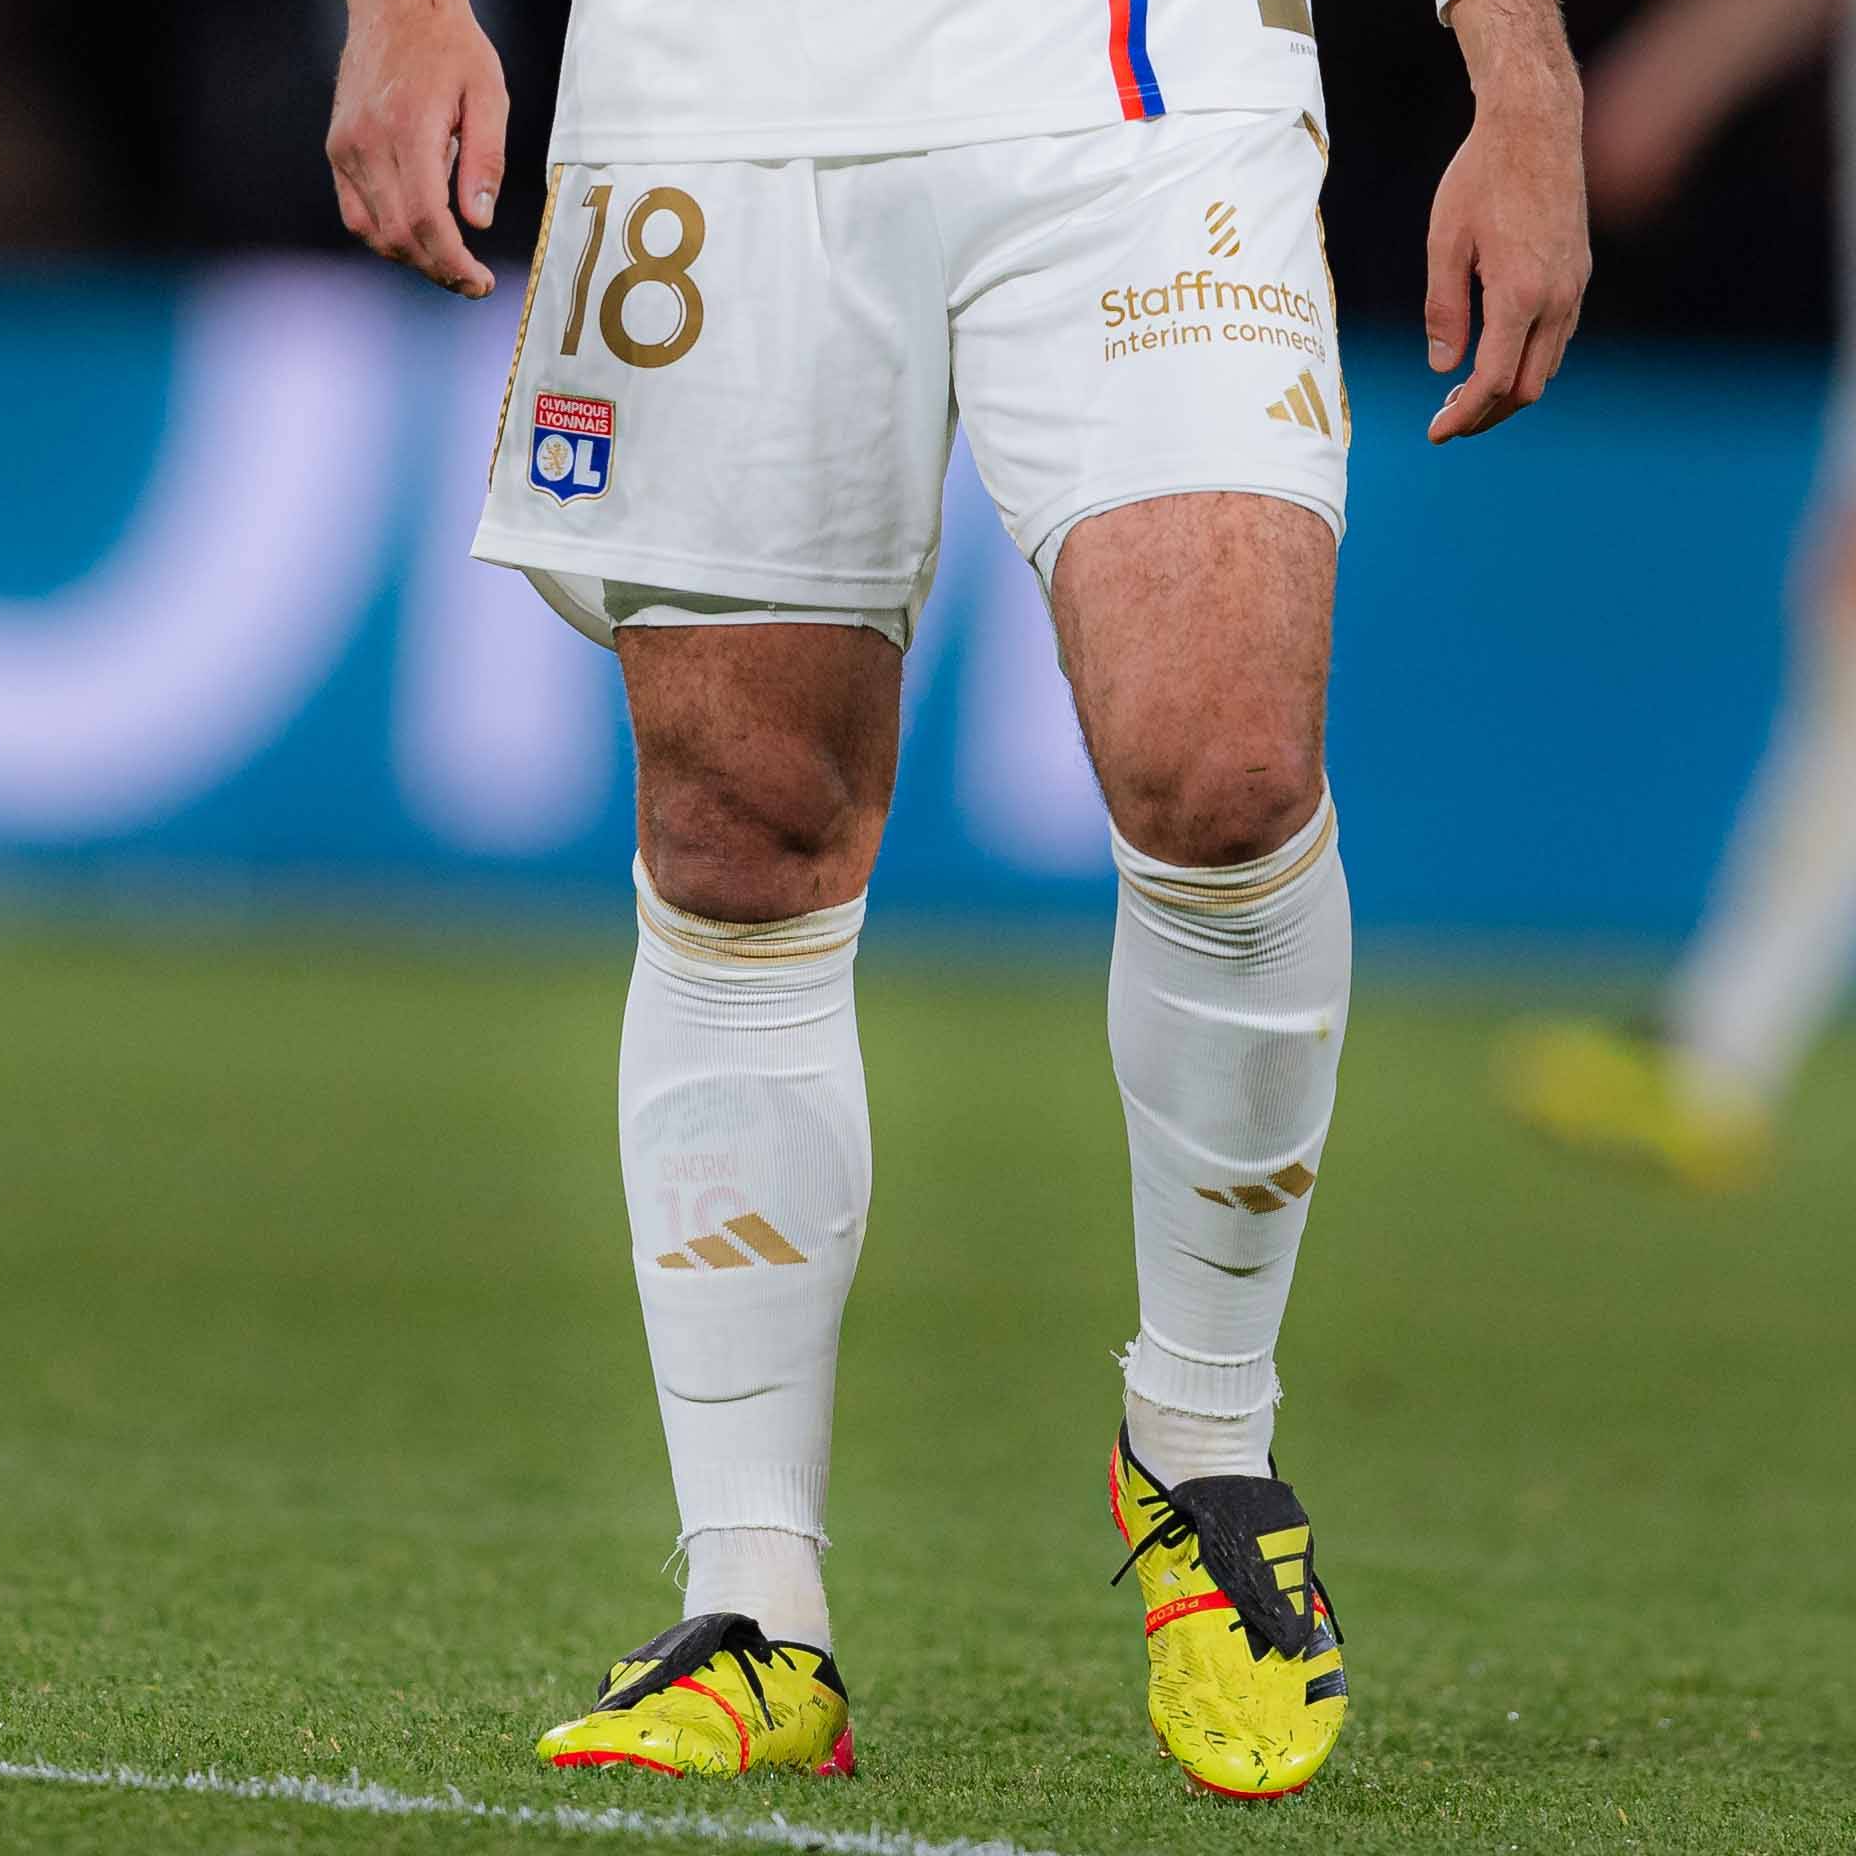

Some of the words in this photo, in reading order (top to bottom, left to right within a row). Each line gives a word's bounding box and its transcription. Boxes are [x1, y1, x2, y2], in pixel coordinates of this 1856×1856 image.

[560, 184, 706, 369] 18
[1100, 270, 1323, 333] Staffmatch
[1104, 320, 1212, 362] intérim
[539, 410, 609, 433] LYONNAIS
[540, 397, 609, 418] OLYMPIQUE
[536, 434, 601, 488] OL
